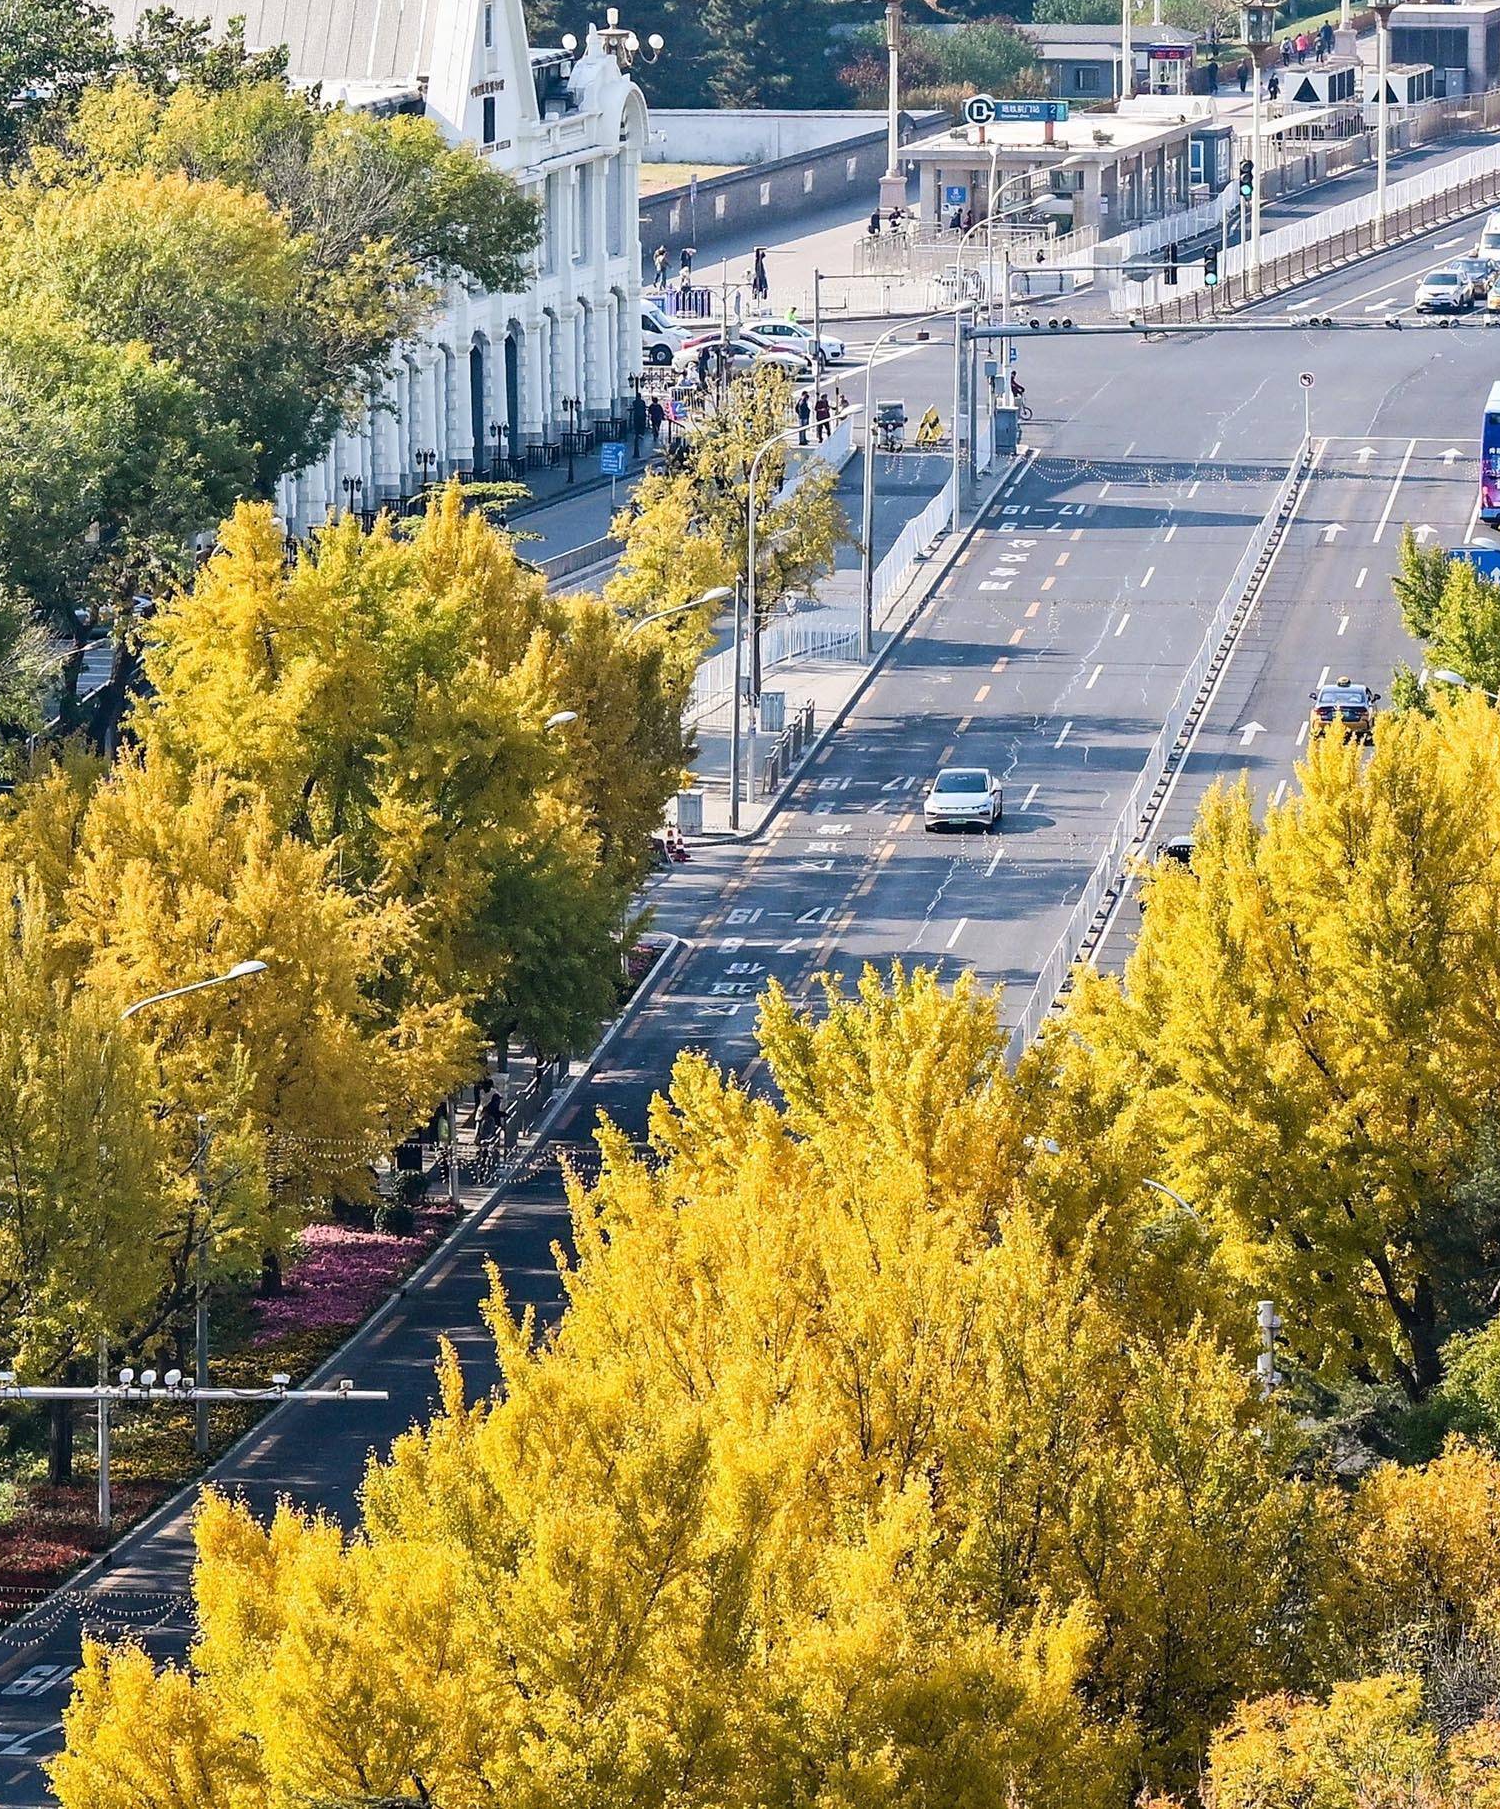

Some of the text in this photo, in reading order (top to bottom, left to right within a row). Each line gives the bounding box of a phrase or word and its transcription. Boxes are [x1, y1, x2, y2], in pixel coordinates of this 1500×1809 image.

[1001, 504, 1086, 515] 17-19
[997, 522, 1062, 532] 7-9
[818, 776, 917, 791] 17-19
[725, 906, 836, 925] 17-19
[717, 937, 804, 954] 7-9
